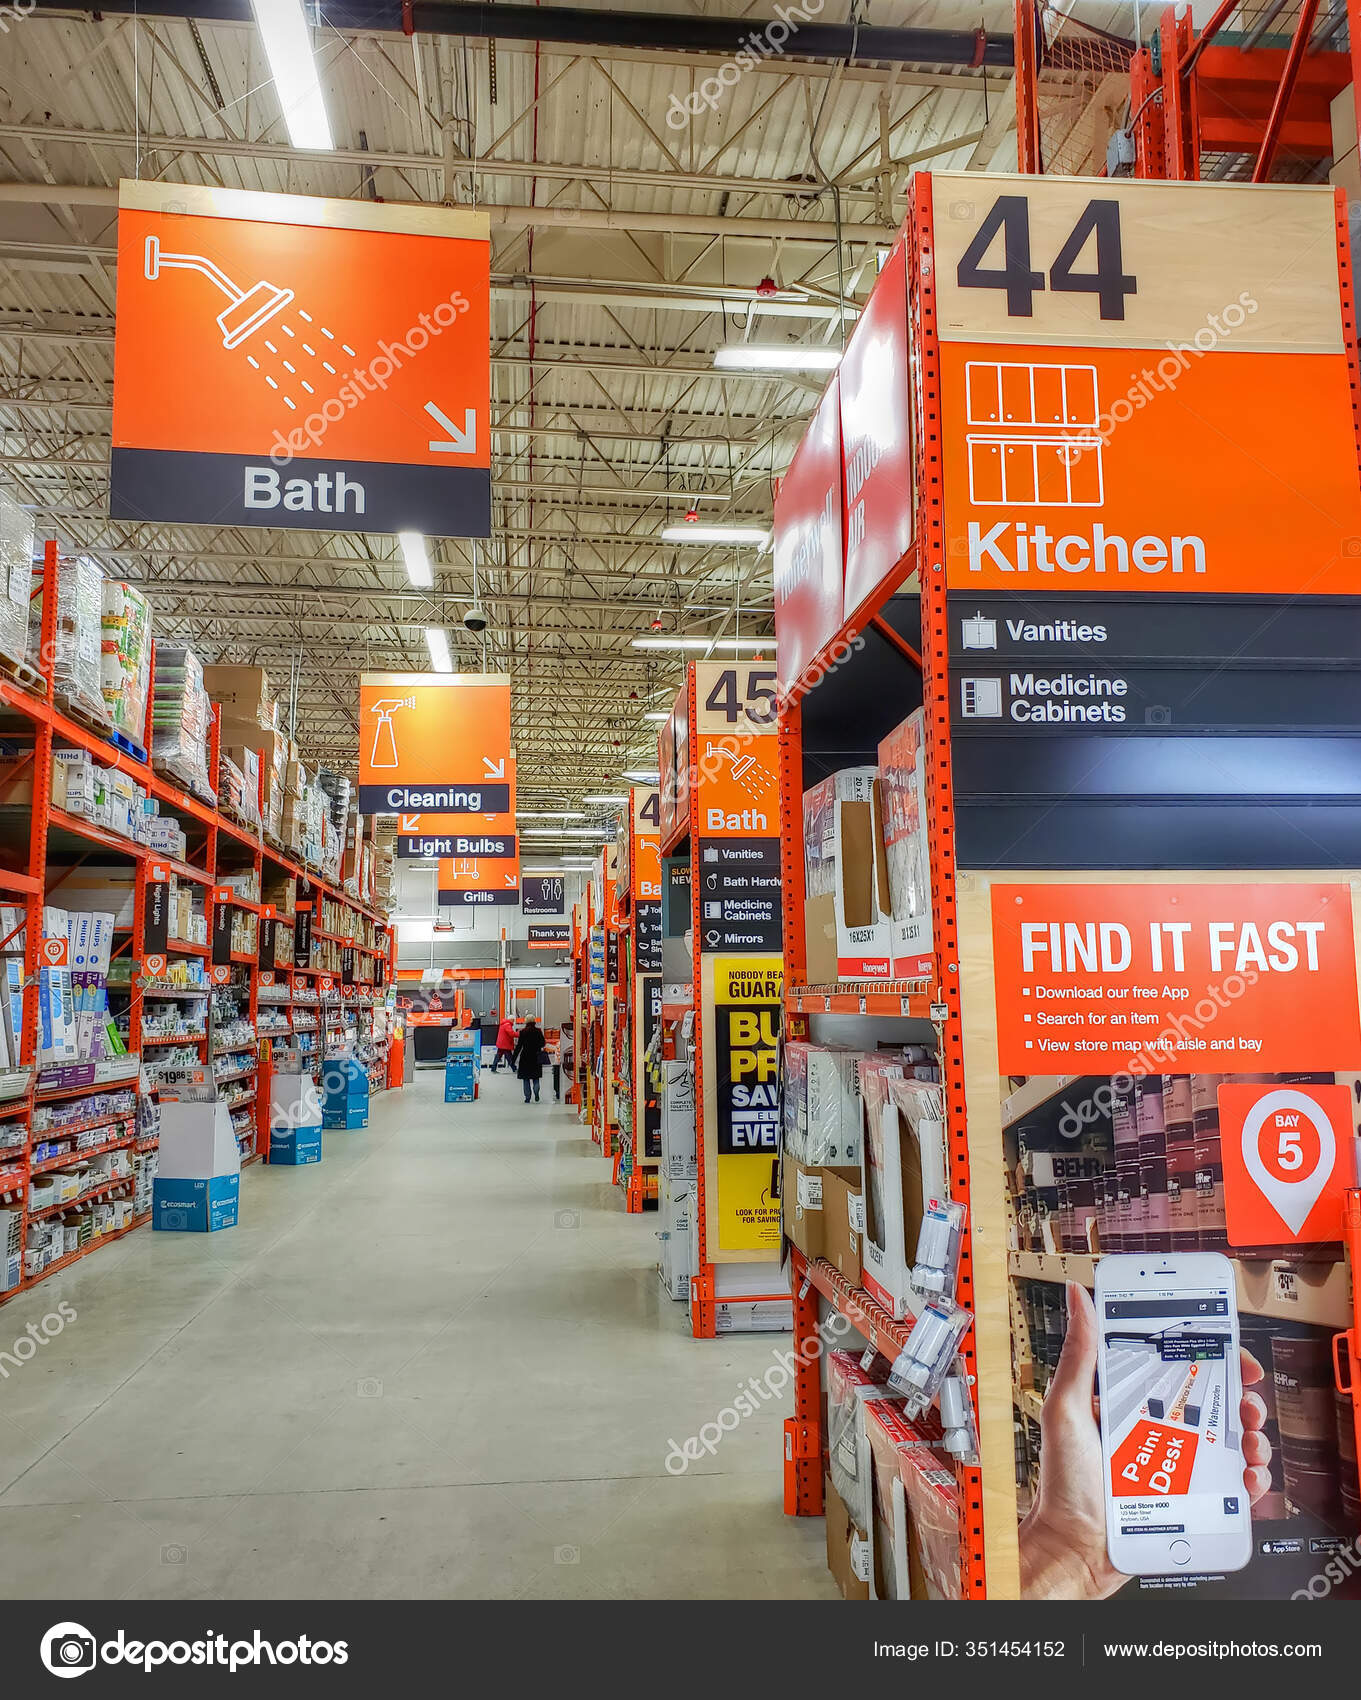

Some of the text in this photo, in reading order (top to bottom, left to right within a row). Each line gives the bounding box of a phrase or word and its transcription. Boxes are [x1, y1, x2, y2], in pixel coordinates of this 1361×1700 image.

[957, 195, 1137, 321] 44
[245, 466, 366, 514] Bath
[967, 521, 1207, 574] Kitchen
[1005, 619, 1108, 642] Vanities
[1009, 673, 1128, 696] Medicine
[705, 670, 778, 725] 45
[1010, 699, 1126, 722] Cabinets
[387, 789, 482, 812] Cleaning
[707, 808, 767, 831] Bath
[408, 838, 505, 856] Light Bulbs
[722, 849, 764, 859] Vanities
[723, 876, 748, 887] Bath
[154, 885, 162, 903] Night
[463, 891, 494, 902] Grills
[724, 900, 773, 910] Medicine
[724, 911, 772, 920] Cabinets
[80, 920, 88, 947] PHILIPS
[93, 920, 102, 947] PHILIPS
[724, 934, 764, 943] Mirrors
[1021, 921, 1325, 973] FIND IT FAST
[729, 971, 764, 980] NOBODY
[1036, 986, 1189, 1000] Download our free App
[1036, 1012, 1159, 1025] Search for an item
[1037, 1037, 1263, 1053] View store map with aisle and bay
[1275, 1115, 1299, 1128] BAY
[732, 1124, 779, 1147] EVE
[1277, 1132, 1303, 1170] 5
[166, 1201, 196, 1209] ecosmart
[736, 1208, 753, 1216] LOOK
[755, 1208, 767, 1216] FOR
[1206, 1429, 1217, 1444] 47
[1121, 1430, 1162, 1482] Paint
[1148, 1437, 1185, 1494] Desk
[1120, 1502, 1136, 1510] Local
